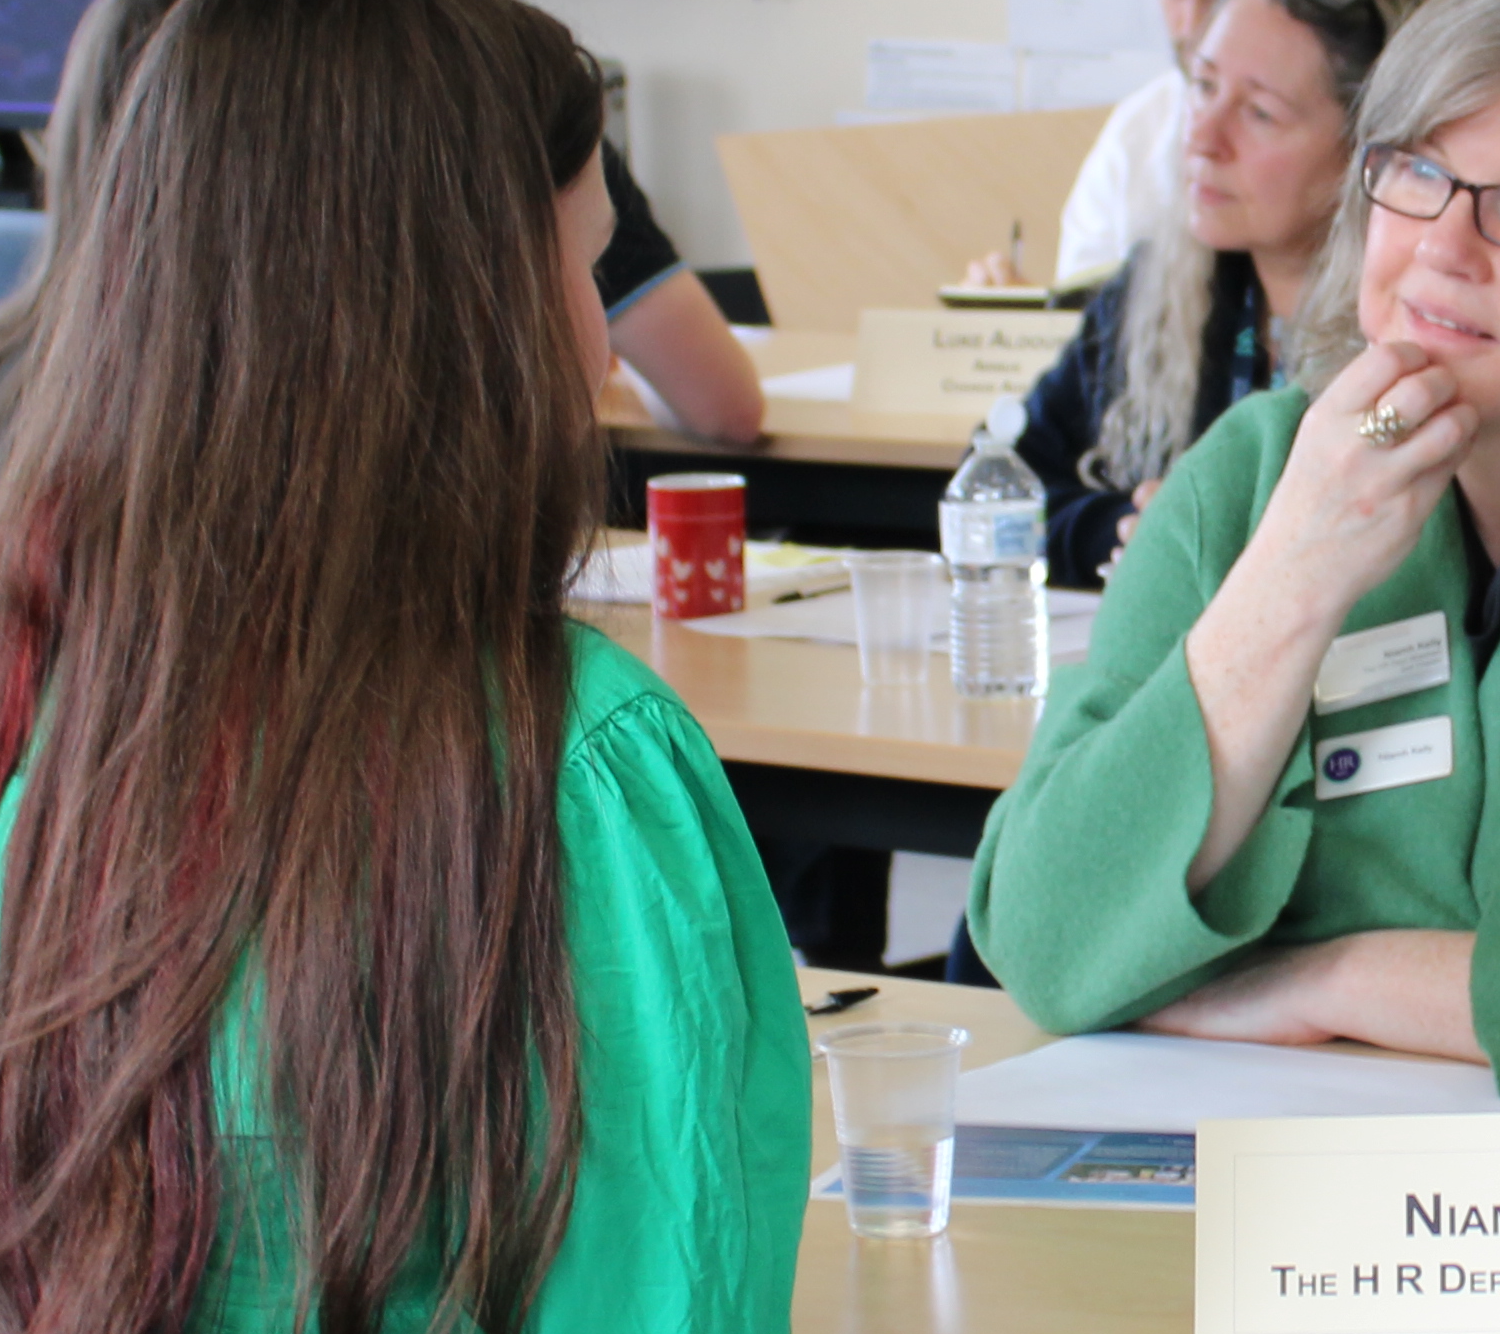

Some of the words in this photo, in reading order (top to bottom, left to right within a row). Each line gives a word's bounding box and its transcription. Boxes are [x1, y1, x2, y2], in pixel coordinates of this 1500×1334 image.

[1271, 1265, 1339, 1298] THE
[1352, 1264, 1380, 1295] H
[1397, 1264, 1424, 1295] R
